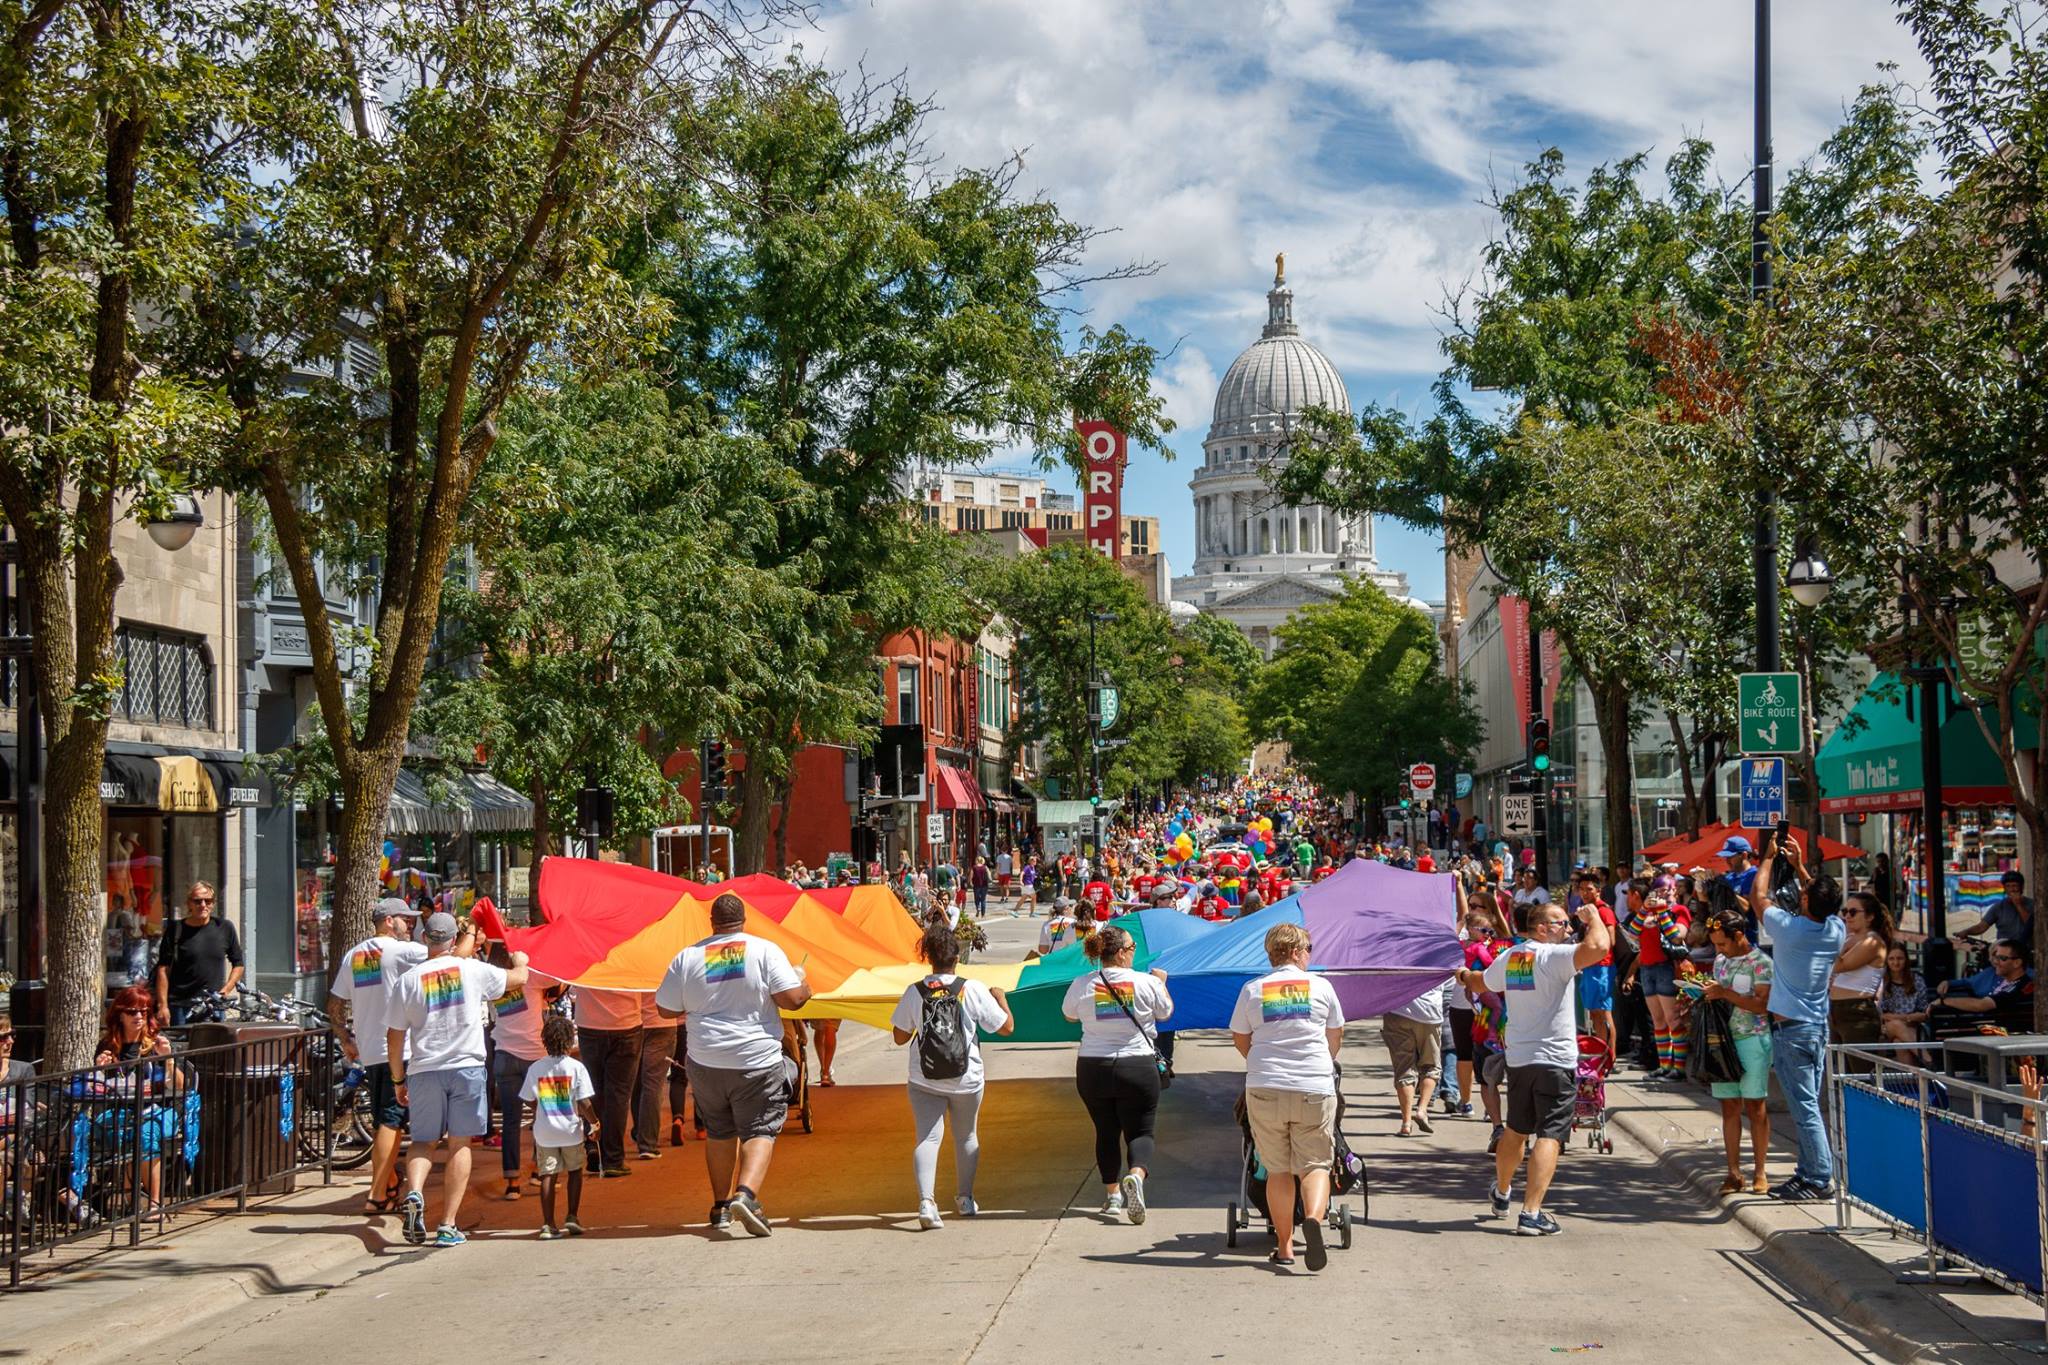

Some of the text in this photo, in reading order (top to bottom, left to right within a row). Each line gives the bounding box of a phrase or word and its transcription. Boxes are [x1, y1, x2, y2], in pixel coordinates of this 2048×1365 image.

[1743, 707, 1796, 718] BIKE ROUTE
[100, 782, 125, 798] SHOES
[170, 781, 209, 808] Citrine
[1746, 787, 1781, 799] 4 6 29
[1505, 799, 1528, 809] ONE
[930, 817, 942, 825] ONE
[1505, 811, 1529, 820] WAY
